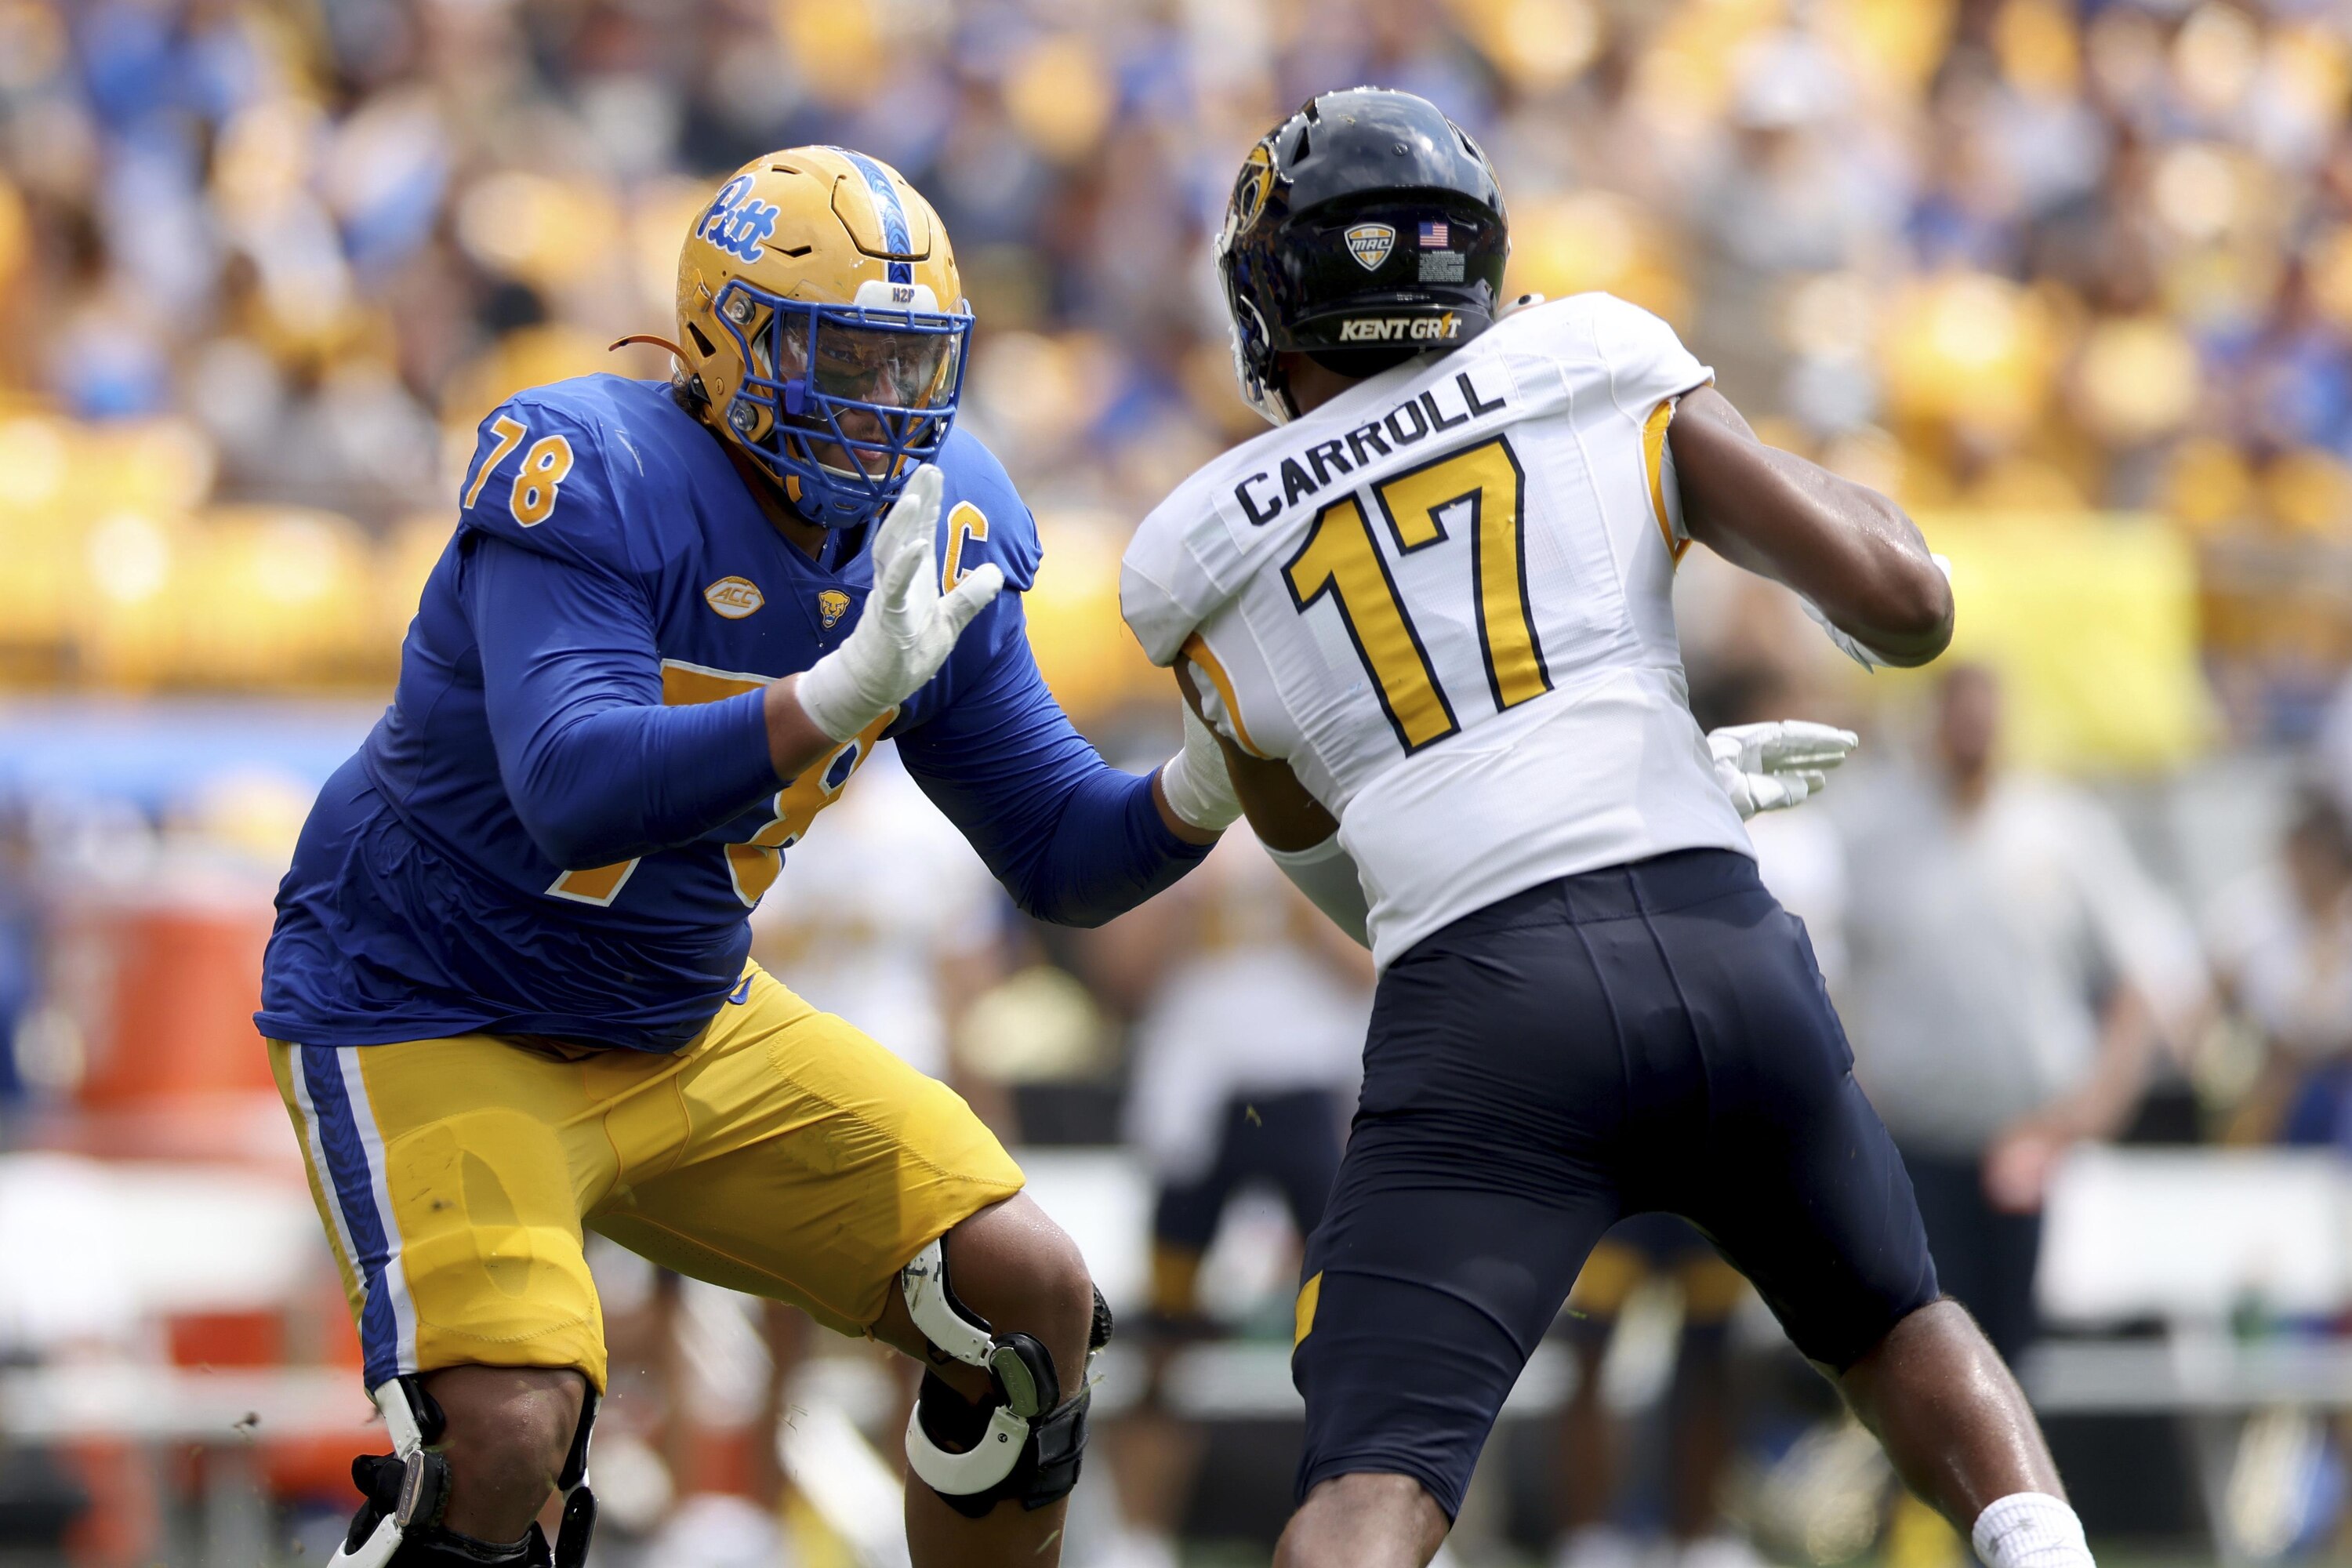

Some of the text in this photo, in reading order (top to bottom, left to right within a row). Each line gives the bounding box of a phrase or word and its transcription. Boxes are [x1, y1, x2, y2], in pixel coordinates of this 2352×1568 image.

[696, 174, 781, 264] Pitt
[1351, 238, 1391, 251] MAC
[892, 287, 915, 303] H2P
[1340, 319, 1410, 340] KENT
[463, 414, 574, 528] 78
[1234, 372, 1507, 527] CARROLL
[942, 500, 989, 597] C
[712, 587, 757, 604] ACC
[1280, 433, 1555, 758] 17
